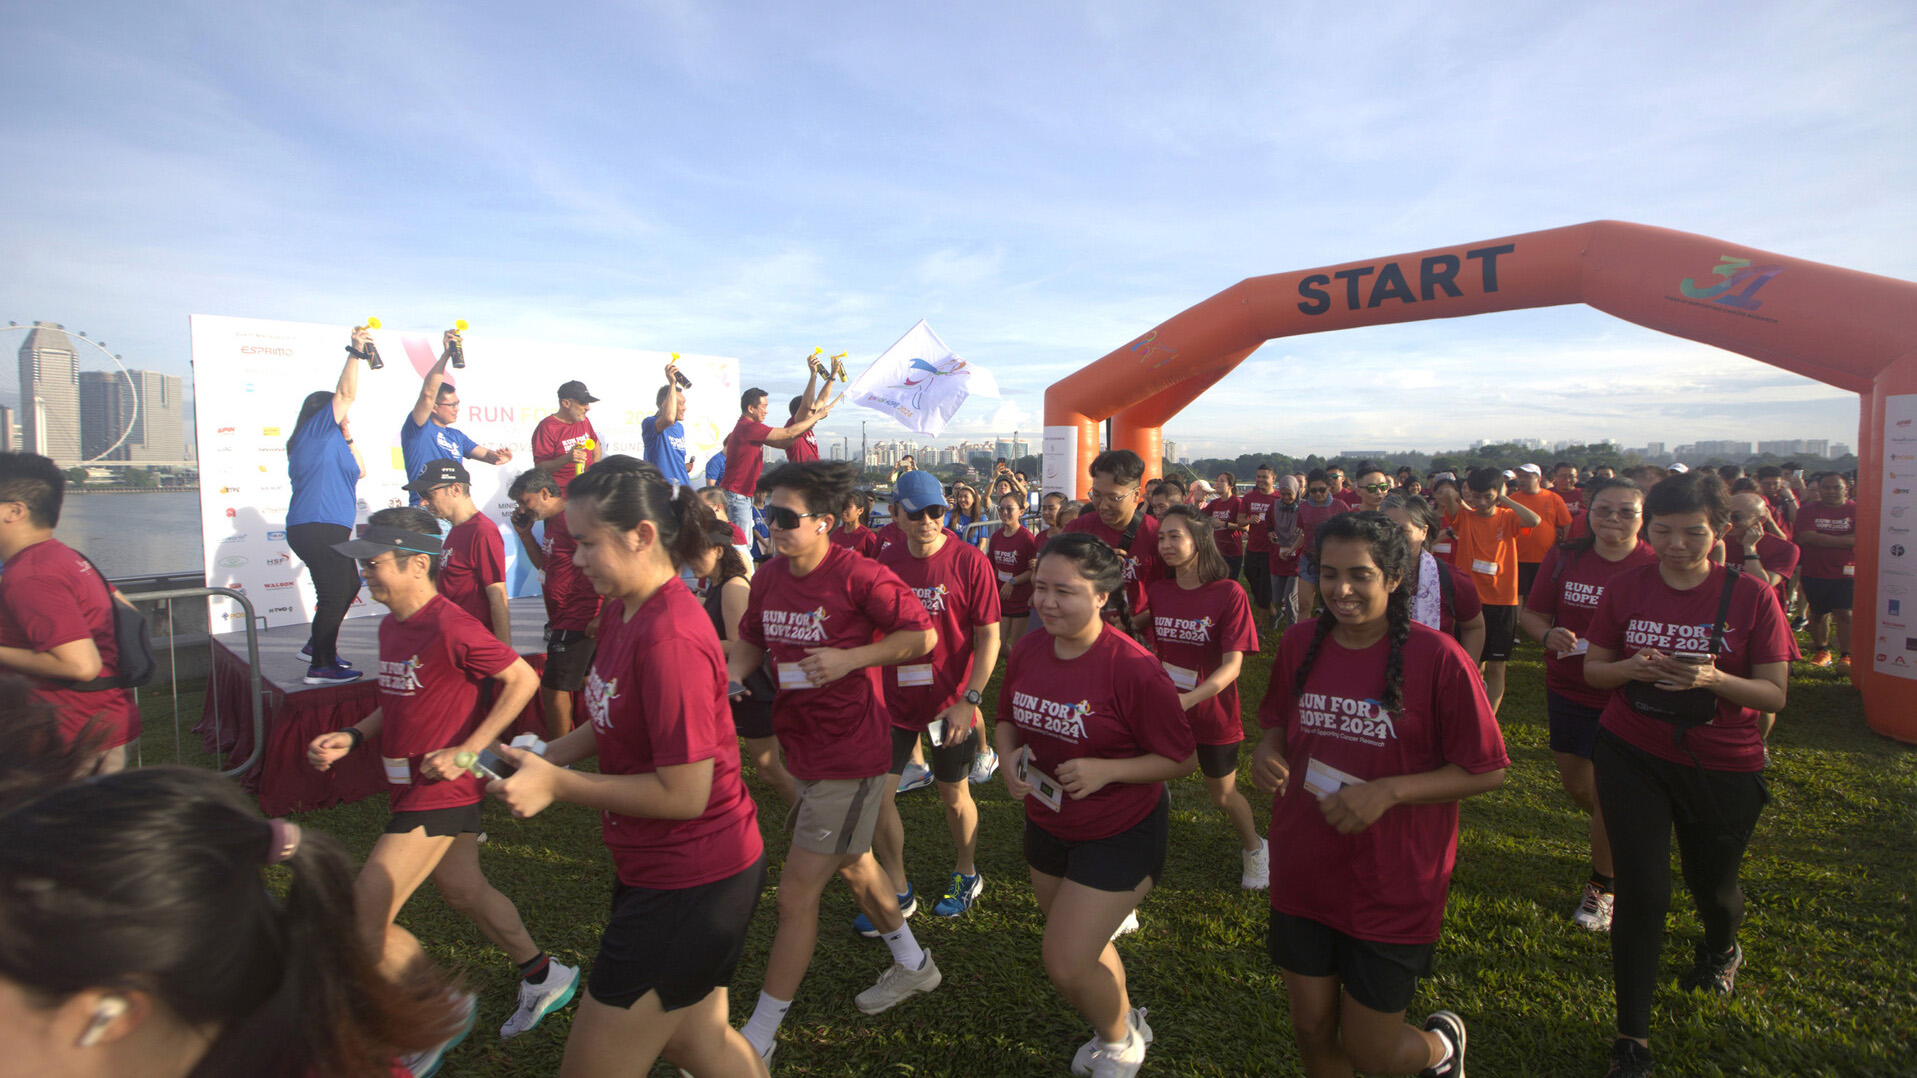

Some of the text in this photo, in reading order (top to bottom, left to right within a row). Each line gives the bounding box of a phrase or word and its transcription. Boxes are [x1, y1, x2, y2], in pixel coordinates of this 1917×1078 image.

[1297, 243, 1515, 315] START
[240, 345, 294, 357] ESPRIMO
[468, 405, 514, 424] RUN
[264, 581, 295, 589] WALSON
[1564, 581, 1595, 595] RUN
[921, 600, 940, 611] 024
[1564, 590, 1600, 605] HOPE
[762, 609, 810, 627] RUN FOR
[1174, 618, 1197, 631] FOR
[762, 623, 791, 638] HOPE
[790, 626, 821, 642] 2024
[1178, 629, 1206, 642] 2024
[1627, 619, 1706, 638] RUN FOR
[1625, 631, 1710, 652] HOPE 202
[1011, 691, 1070, 719] RUN FOR
[1330, 696, 1371, 719] FOR
[1044, 716, 1080, 738] 2024
[1299, 709, 1387, 740] HOPE 2024
[1340, 732, 1359, 742] Cancer
